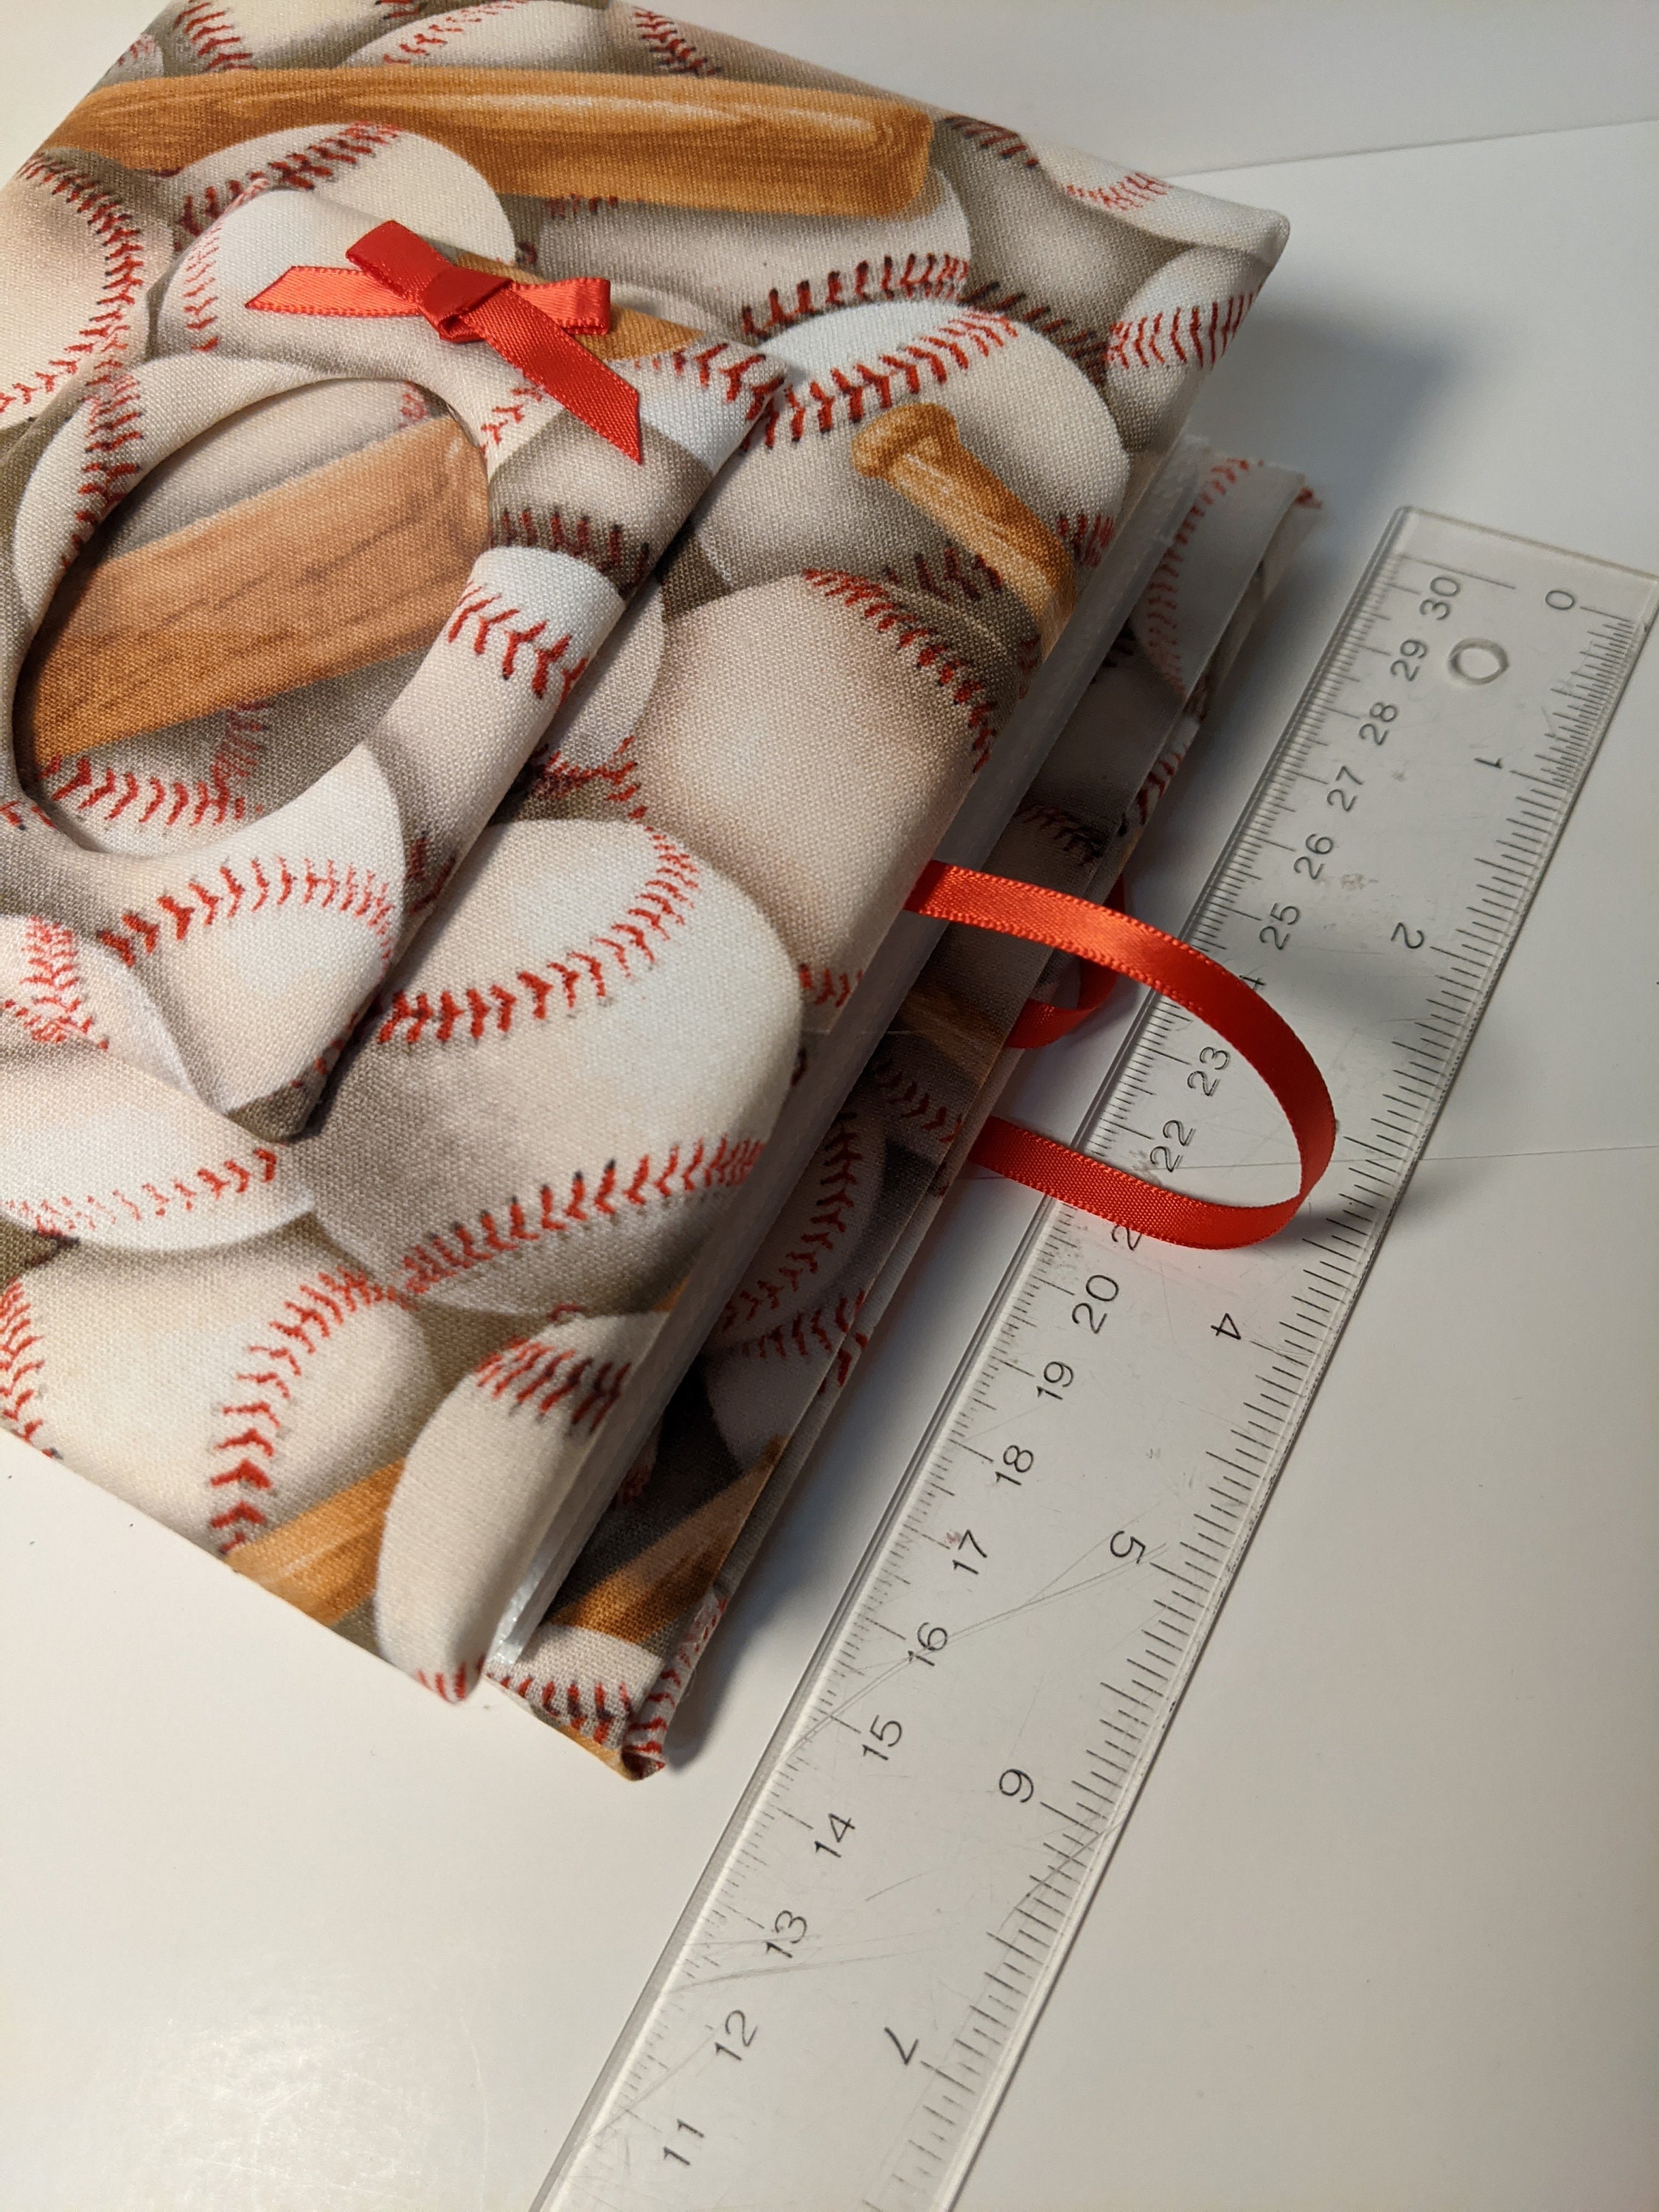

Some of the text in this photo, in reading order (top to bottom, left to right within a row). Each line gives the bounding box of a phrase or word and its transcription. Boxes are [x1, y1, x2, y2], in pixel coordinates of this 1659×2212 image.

[1419, 575, 1461, 621] 30
[1544, 589, 1576, 611] 0
[1390, 639, 1428, 683] 29
[1359, 701, 1399, 746] 28
[1473, 755, 1503, 770] 1
[1327, 765, 1365, 813] 27
[1294, 832, 1335, 880] 26
[1259, 902, 1301, 950] 25
[1390, 922, 1425, 950] 2
[1239, 975, 1267, 990] 4
[1186, 1046, 1231, 1096] 23
[1150, 1119, 1196, 1173] 22
[1110, 1224, 1142, 1252] 2
[1071, 1273, 1120, 1335] 20
[1209, 1311, 1242, 1340] 4
[1035, 1360, 1075, 1401] 19
[995, 1444, 1034, 1486] 18
[952, 1528, 988, 1575] 17
[1109, 1529, 1147, 1564] 5
[907, 1621, 948, 1666] 16
[861, 1714, 903, 1761] 15
[998, 1767, 1034, 1804] 6
[814, 1812, 856, 1859] 14
[765, 1909, 808, 1958] 13
[714, 2008, 759, 2062] 12
[884, 2026, 919, 2066] 7
[663, 2118, 705, 2166] 11
